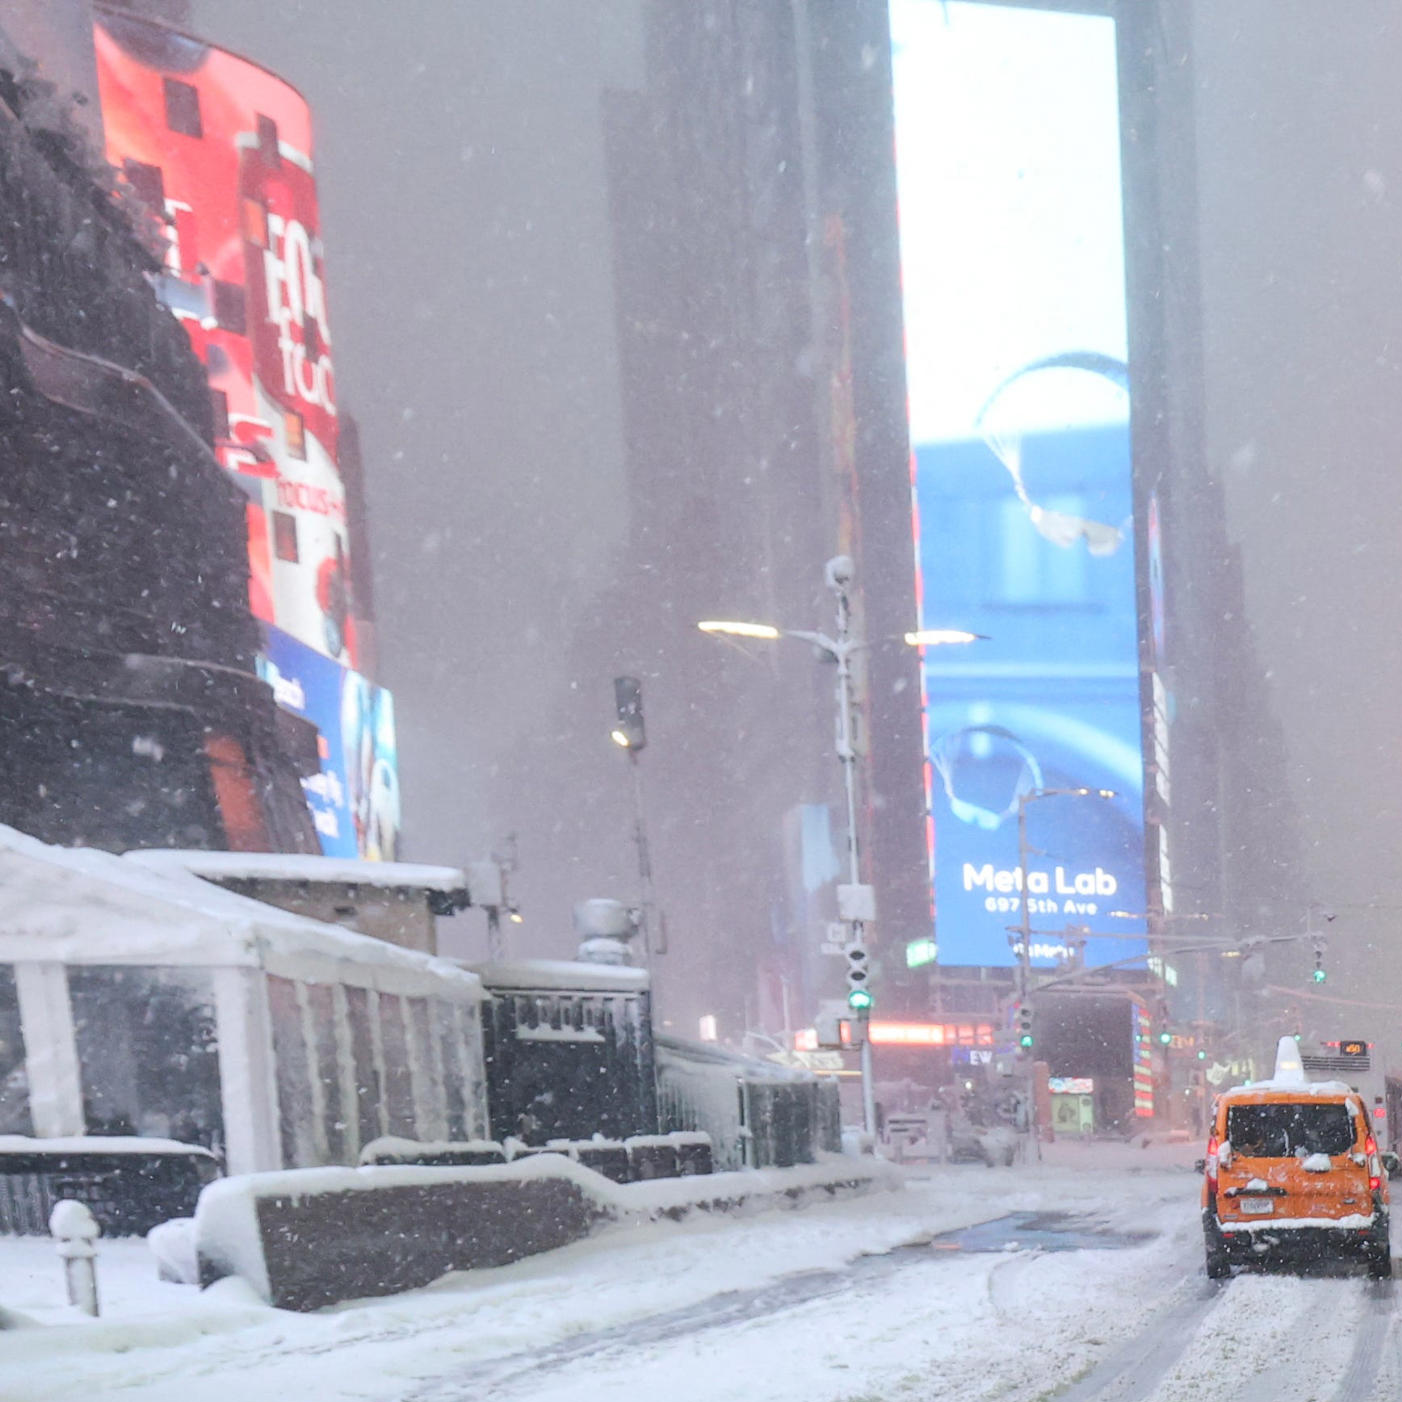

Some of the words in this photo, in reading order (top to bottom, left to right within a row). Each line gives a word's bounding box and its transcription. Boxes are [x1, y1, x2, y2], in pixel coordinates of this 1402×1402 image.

[963, 863, 1049, 893] Meta
[1055, 866, 1118, 896] Lab
[985, 897, 1020, 913] 697
[1027, 899, 1058, 914] 5th
[1063, 899, 1098, 916] Ave
